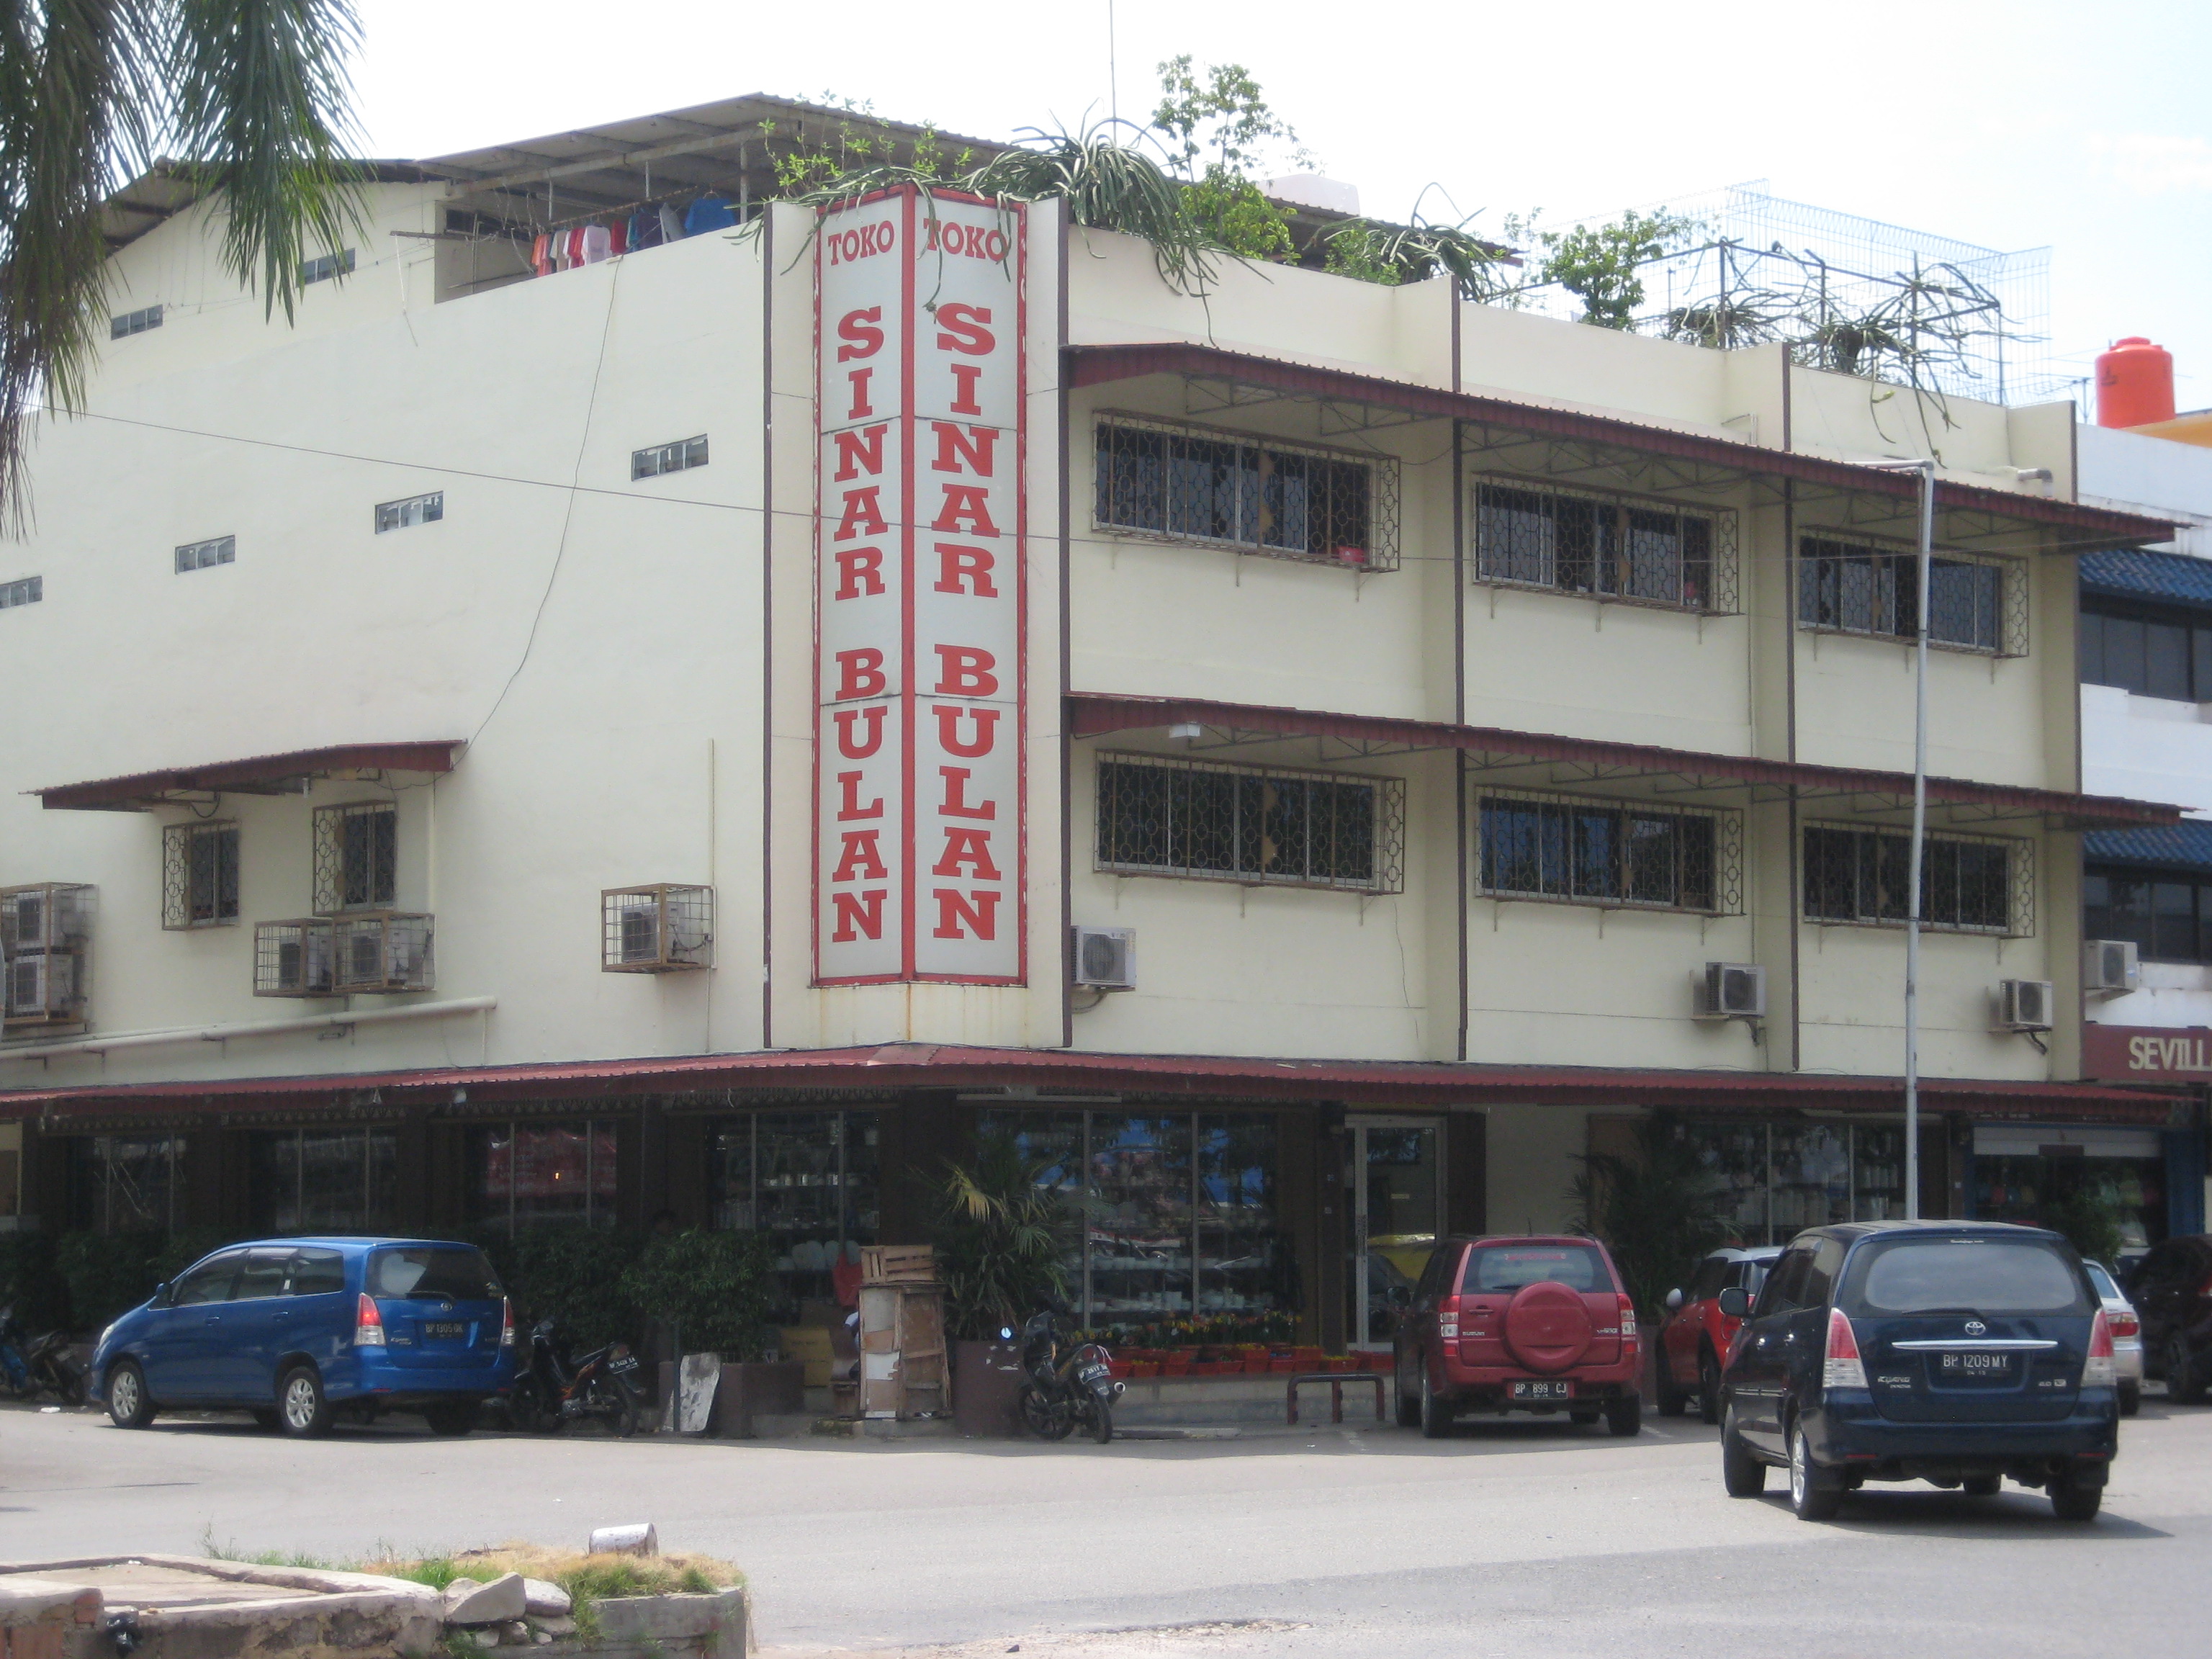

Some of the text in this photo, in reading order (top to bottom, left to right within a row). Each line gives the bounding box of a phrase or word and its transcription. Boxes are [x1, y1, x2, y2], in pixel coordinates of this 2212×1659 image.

[828, 220, 894, 266] TOKO
[923, 218, 1007, 262] TOKO
[832, 305, 889, 943] SINAR BULAN
[932, 302, 1002, 941] SINAR BULAN
[2128, 1036, 2212, 1071] SEVILL
[1963, 1354, 1990, 1367] 1209
[1992, 1355, 2008, 1367] MY
[1515, 1383, 1526, 1393] BP
[1532, 1383, 1549, 1393] 899
